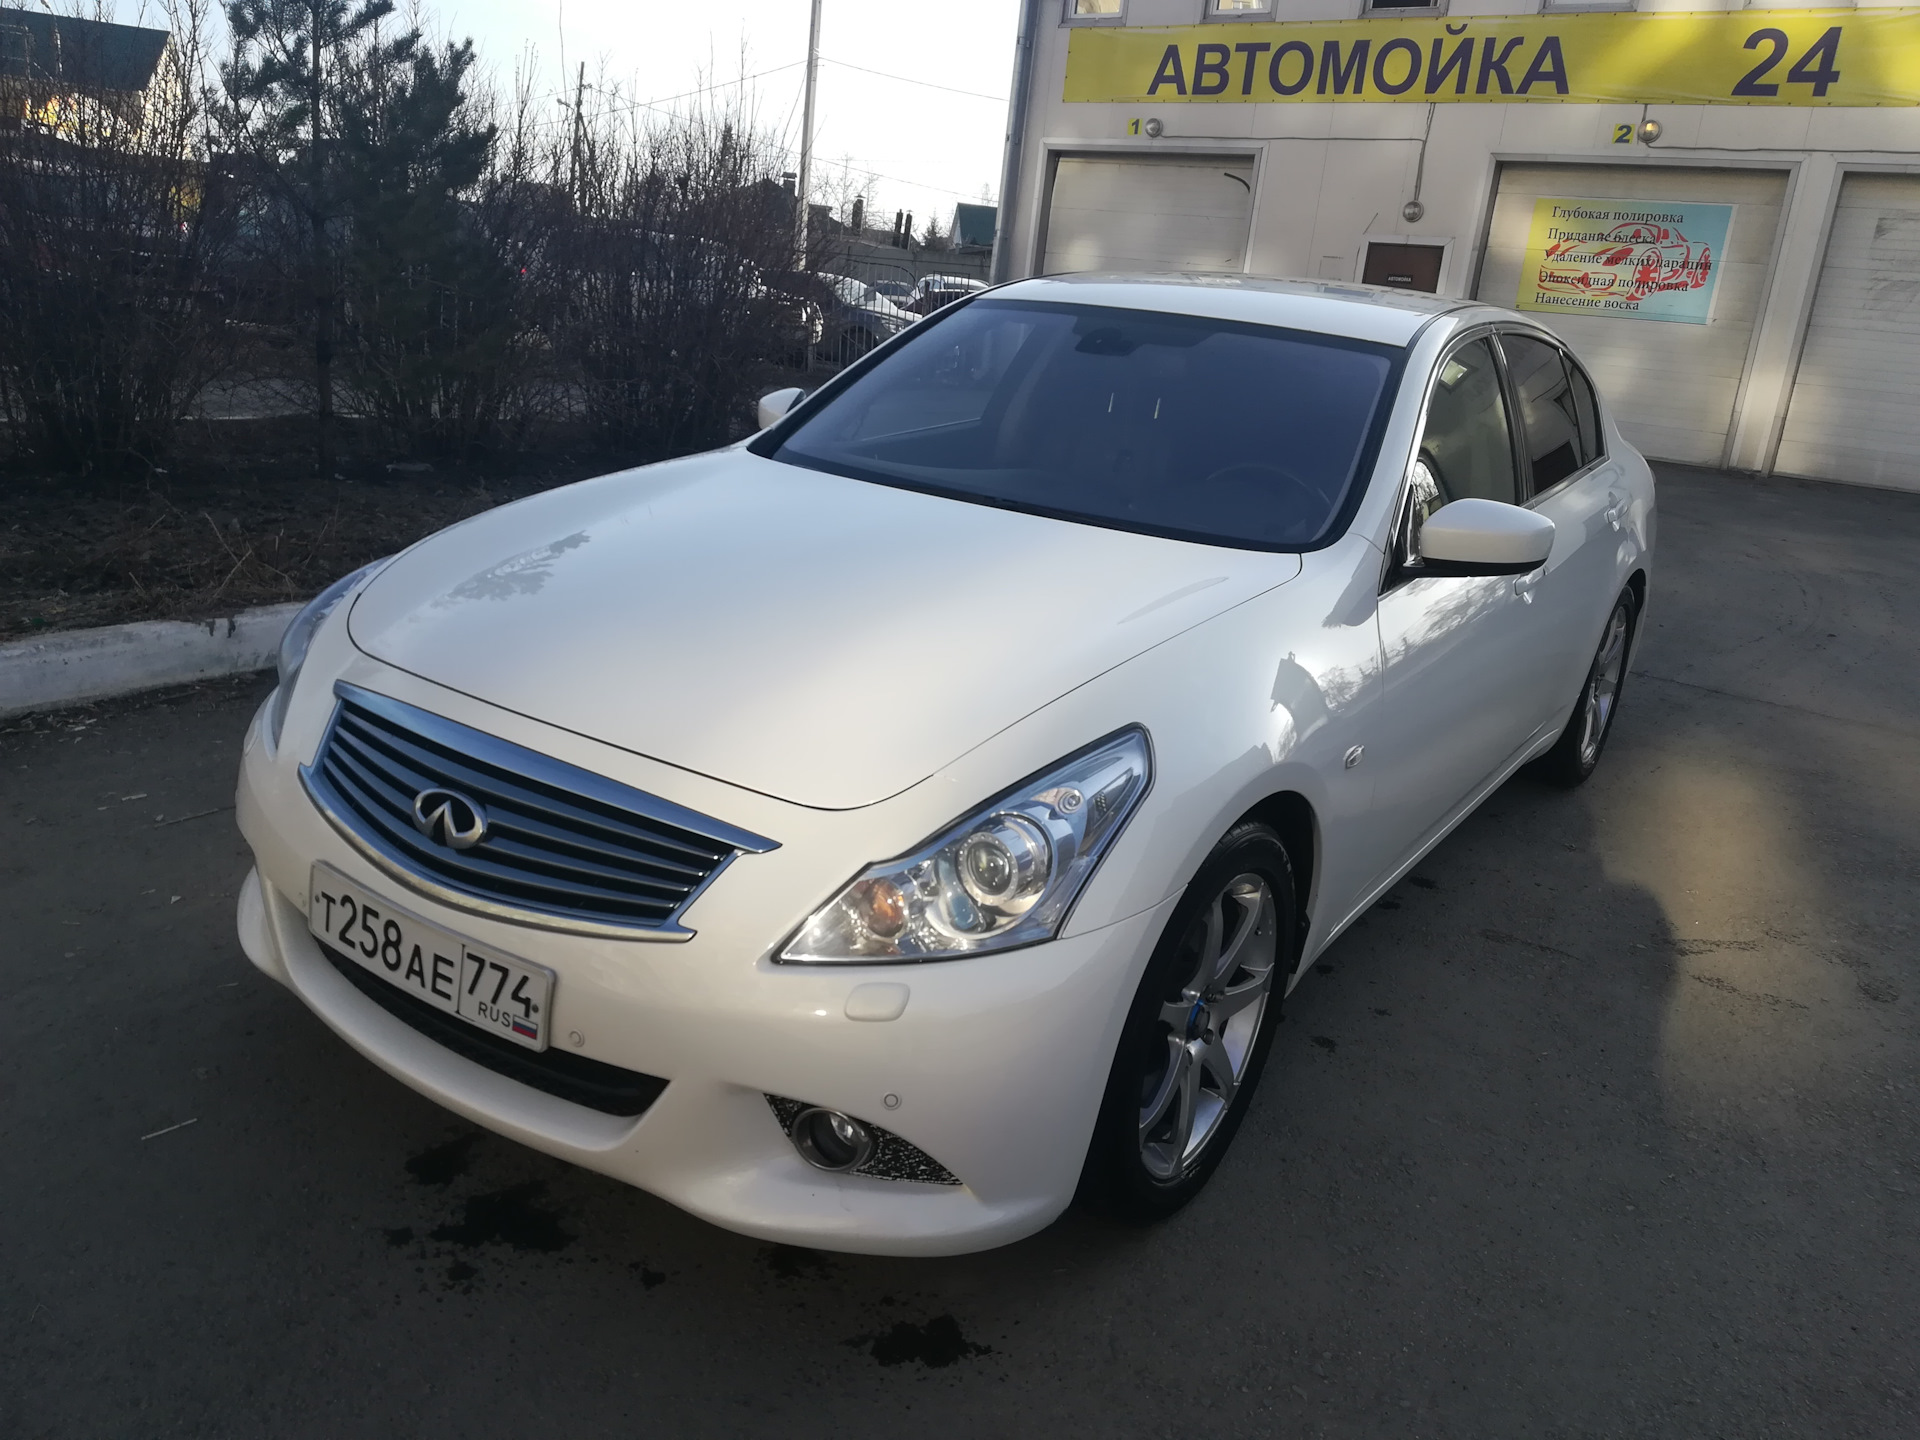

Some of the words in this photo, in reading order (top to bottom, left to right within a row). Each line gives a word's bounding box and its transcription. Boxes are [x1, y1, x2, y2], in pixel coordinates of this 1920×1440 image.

[1146, 23, 1570, 96] АВТОМОЙКА
[1730, 26, 1843, 97] 24
[1130, 118, 1141, 136] 1
[1614, 124, 1633, 144] 2
[1551, 205, 1609, 221] Глубокая
[1612, 211, 1684, 224] полировка
[1547, 227, 1611, 243] Придание
[1613, 230, 1656, 244] блеска
[1543, 250, 1603, 264] Удаление
[1605, 255, 1655, 267] мелких
[1655, 258, 1713, 271] царапин
[1539, 270, 1615, 288] Эпоксидная
[1618, 279, 1689, 293] полировка
[1534, 292, 1601, 308] Нанесение
[1603, 299, 1640, 311] воска
[466, 951, 532, 1019] 774
[477, 1001, 511, 1028] RUS
